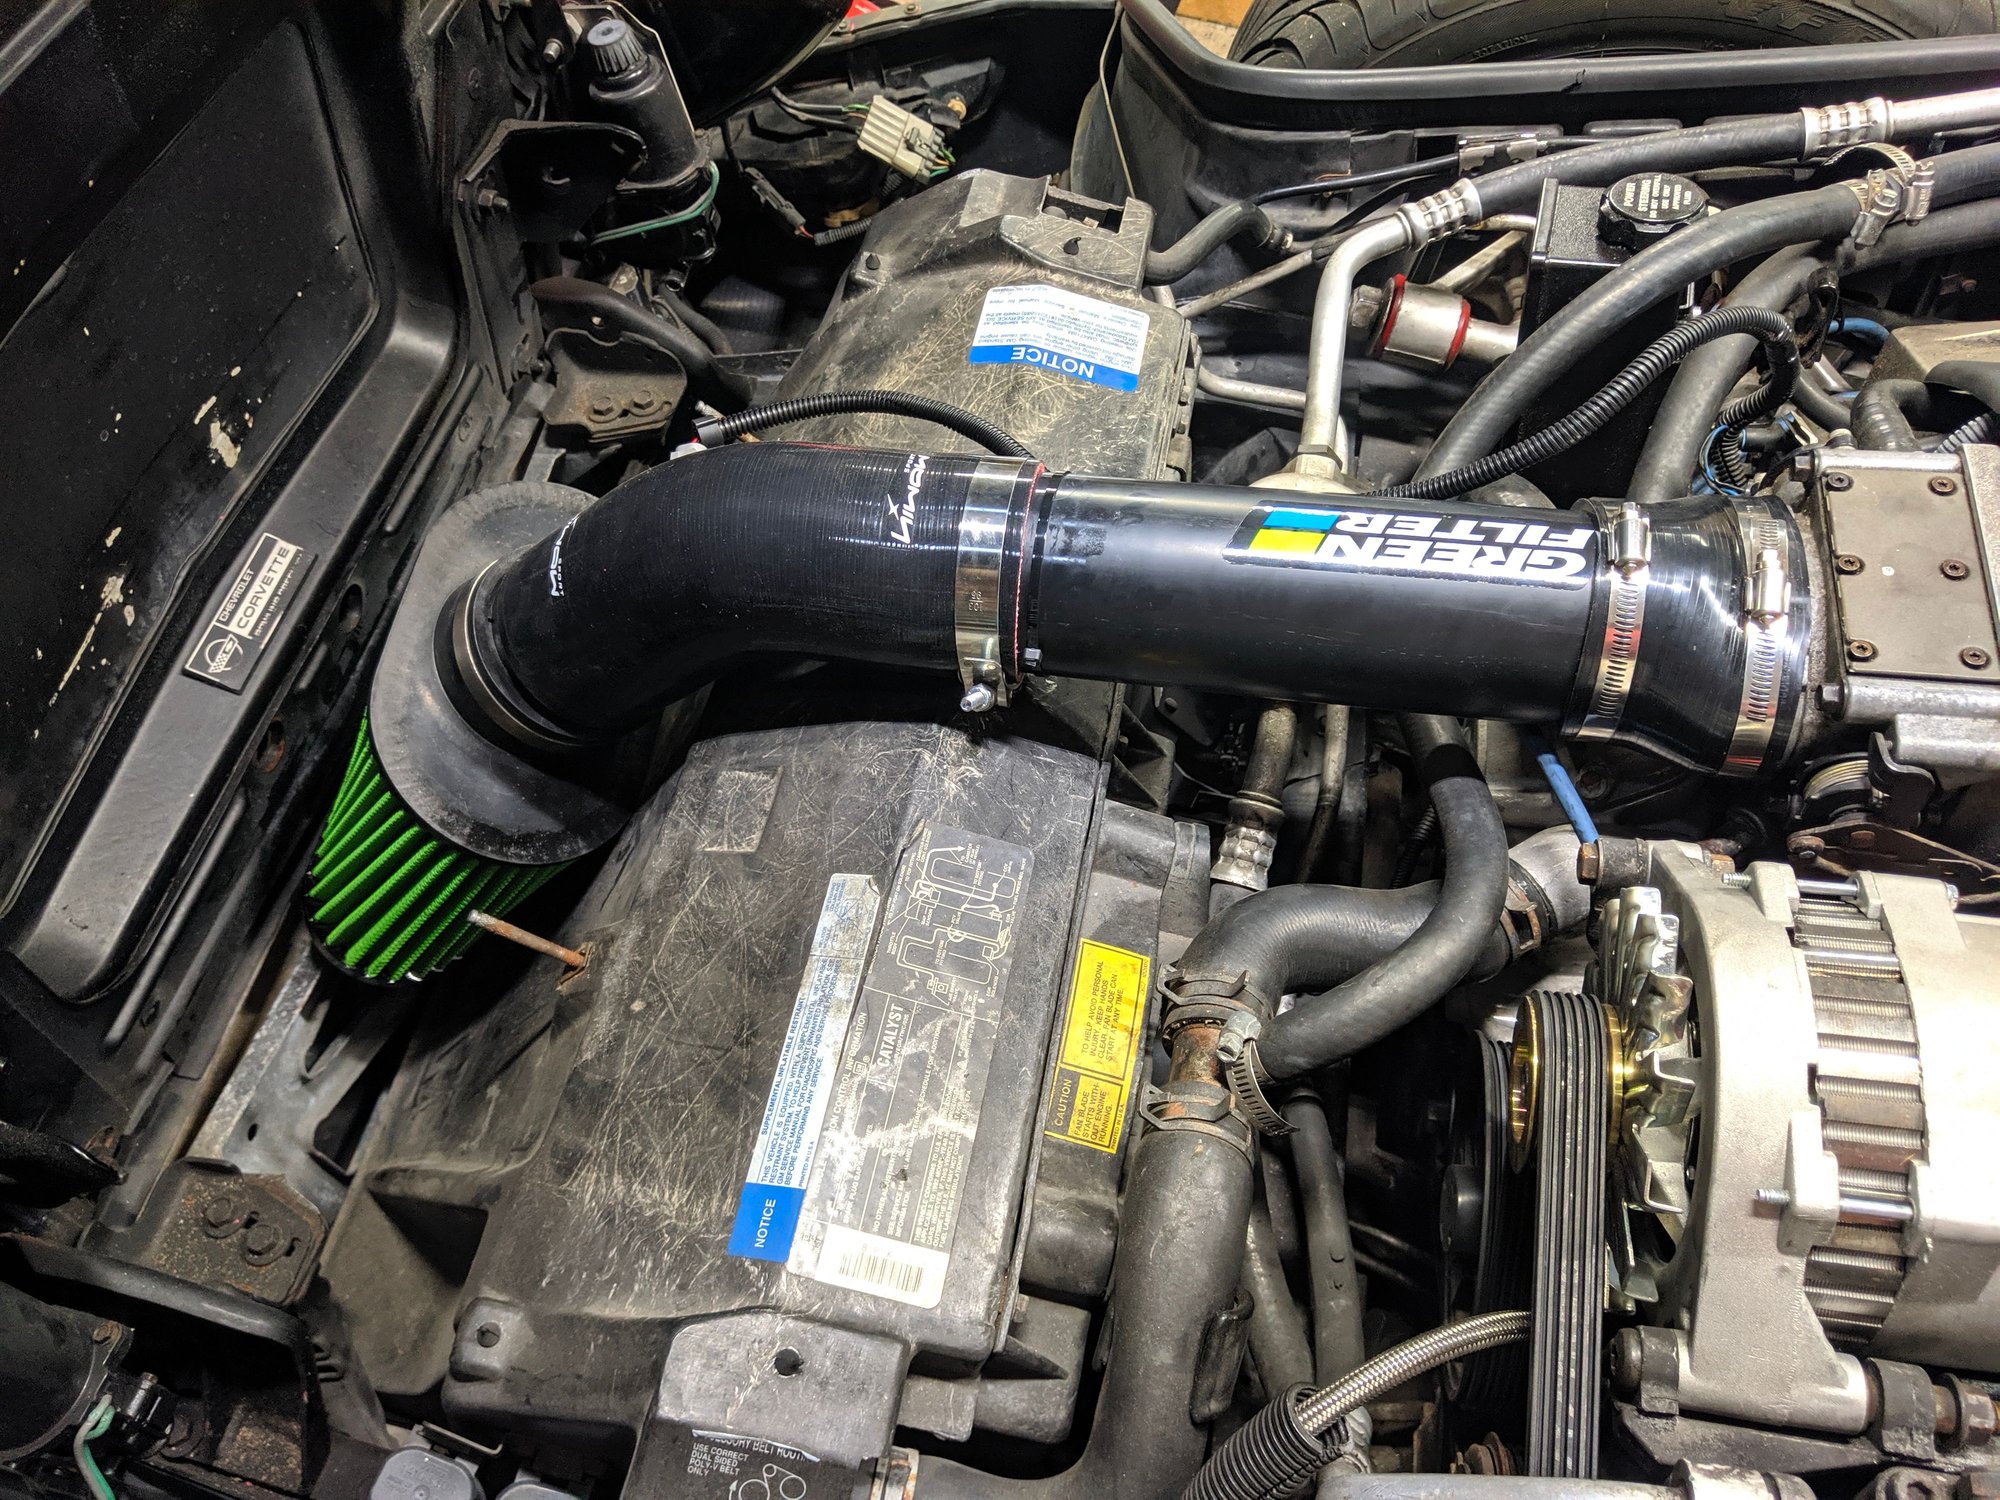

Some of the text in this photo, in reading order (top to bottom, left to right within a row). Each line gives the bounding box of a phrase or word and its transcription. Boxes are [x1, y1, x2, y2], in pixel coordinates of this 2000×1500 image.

[1623, 182, 1635, 206] POWER
[1637, 178, 1651, 211] STEERING
[1011, 347, 1094, 379] NOTICE
[1336, 513, 1595, 549] FILTER
[1316, 534, 1587, 577] GREEN
[218, 566, 255, 622] CHEVROLET
[235, 545, 289, 630] CORVETTE
[1109, 973, 1117, 988] CAN
[1081, 960, 1104, 1053] TO HELP AVOID PERSONAL
[1094, 979, 1109, 1025] KEEP HANDS
[1105, 989, 1115, 1012] BLADE
[1111, 1007, 1120, 1022] ANY
[806, 1007, 821, 1045] UNWANTED
[876, 1002, 904, 1067] CATALYST
[1102, 1014, 1111, 1029] FAN
[1110, 1024, 1117, 1033] AT
[813, 1033, 822, 1047] AND
[1104, 1036, 1115, 1060] START
[761, 996, 804, 1135] SUPPLEMENTAL INFLATABLE RESTRAINT
[797, 1046, 810, 1078] PREVENT
[801, 1048, 818, 1091] DIAGNOSTIC
[832, 1071, 850, 1113] CONTROL
[844, 1011, 867, 1070] INFORMATION
[789, 1099, 796, 1108] TO
[792, 1079, 802, 1097] HELP
[797, 1092, 806, 1107] FOR
[1054, 1078, 1072, 1126] CAUTION
[788, 1108, 802, 1138] MANUAL
[1073, 1090, 1089, 1135] FAN BLADE
[1082, 1106, 1095, 1138] STARTS
[1090, 1090, 1106, 1140] OUT ENGINE
[1098, 1103, 1112, 1142] RUNNING.
[760, 1164, 771, 1182] THIS
[766, 1130, 780, 1162] VEHICLE
[776, 1120, 783, 1128] IS
[784, 1154, 797, 1185] BEFORE
[792, 1105, 811, 1153] PERFORMING
[806, 1089, 814, 1104] ANY
[768, 1141, 785, 1183] RESTRAINT
[779, 1139, 793, 1171] SERVICE
[776, 1171, 785, 1184] GM
[797, 1162, 809, 1187] PRINTED
[890, 1191, 902, 1217] SERVICE
[897, 1162, 909, 1190] MAAL
[753, 1197, 777, 1248] NOTICE
[875, 1196, 886, 1220] OTHER
[690, 1450, 738, 1467] DUAL SIDED
[692, 1442, 749, 1462] USE CORRECT
[686, 1465, 709, 1477] ONLY
[719, 1464, 740, 1475] BELT
